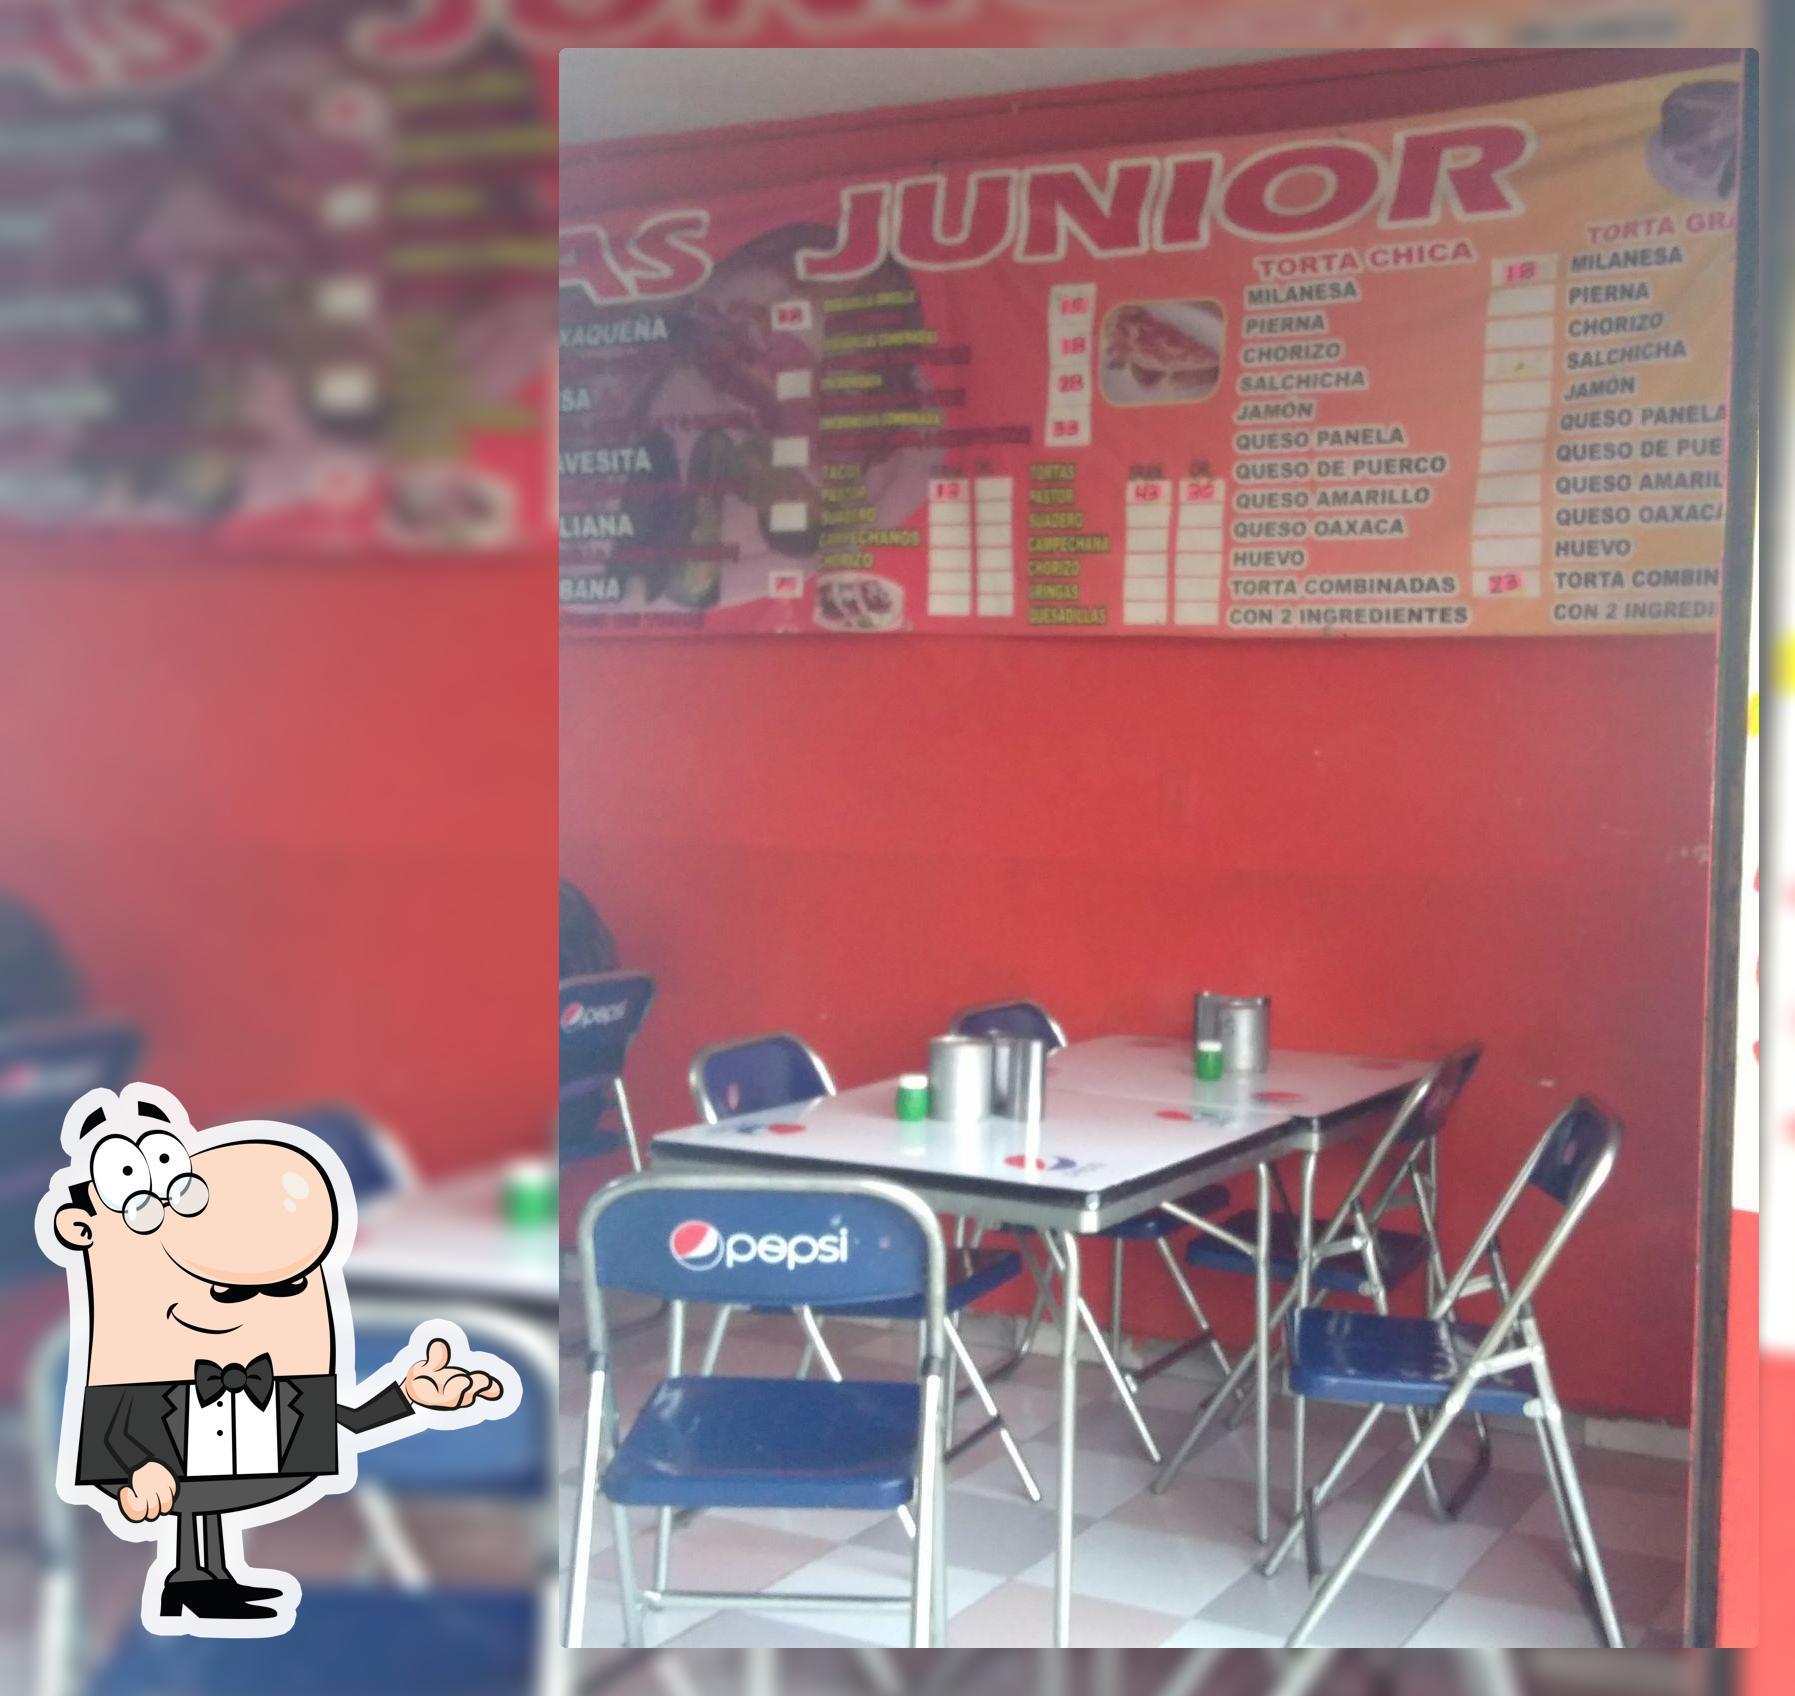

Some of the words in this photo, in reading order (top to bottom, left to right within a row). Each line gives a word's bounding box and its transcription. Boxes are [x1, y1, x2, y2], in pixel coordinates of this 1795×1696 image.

[795, 119, 1537, 282] JUNIOR
[1587, 216, 1676, 245] TORTA
[1258, 252, 1360, 278] TORTA
[1369, 240, 1473, 268] CHICA
[1570, 246, 1684, 273] MILANESA
[1247, 280, 1359, 306] MILANESA
[1568, 281, 1650, 305] PIERNA
[1244, 314, 1326, 335] PIERNA
[1567, 312, 1664, 338] CHORIZO
[1242, 341, 1342, 364] CHORIZO
[1566, 340, 1687, 370] SALCHICHA
[1239, 371, 1367, 393] SALCHICHA
[1236, 400, 1314, 422] JAMÓN
[1559, 409, 1633, 431] QUESO
[1235, 431, 1310, 450] QUESO
[1315, 426, 1405, 446] PANELA
[1556, 442, 1633, 463] QUESO
[1640, 439, 1668, 458] DE
[1676, 437, 1722, 456] PUE
[1234, 461, 1310, 480] QUESO
[1316, 460, 1345, 477] DE
[1352, 455, 1448, 476] PUERCO
[1555, 474, 1632, 495] QUESO
[1638, 470, 1723, 491] AMARIL
[1235, 491, 1309, 510] QUESO
[1315, 486, 1431, 507] AMARILLO
[1555, 506, 1631, 527] QUESO
[1232, 520, 1308, 540] QUESO
[1313, 518, 1405, 537] OAXACA
[1232, 549, 1306, 568] HUEVO
[1554, 538, 1632, 558] HUEVO
[1230, 579, 1298, 596] TORTA
[1303, 575, 1457, 596] COMBINADAS
[1554, 570, 1625, 590] TORTA
[1631, 568, 1719, 589] COMBIN
[1228, 608, 1274, 626] CON
[1280, 608, 1293, 625] 2
[1299, 605, 1469, 627] INGREDIENTES
[1553, 602, 1599, 621] CON
[1604, 601, 1618, 620] 2
[726, 1227, 849, 1271] pepsi
